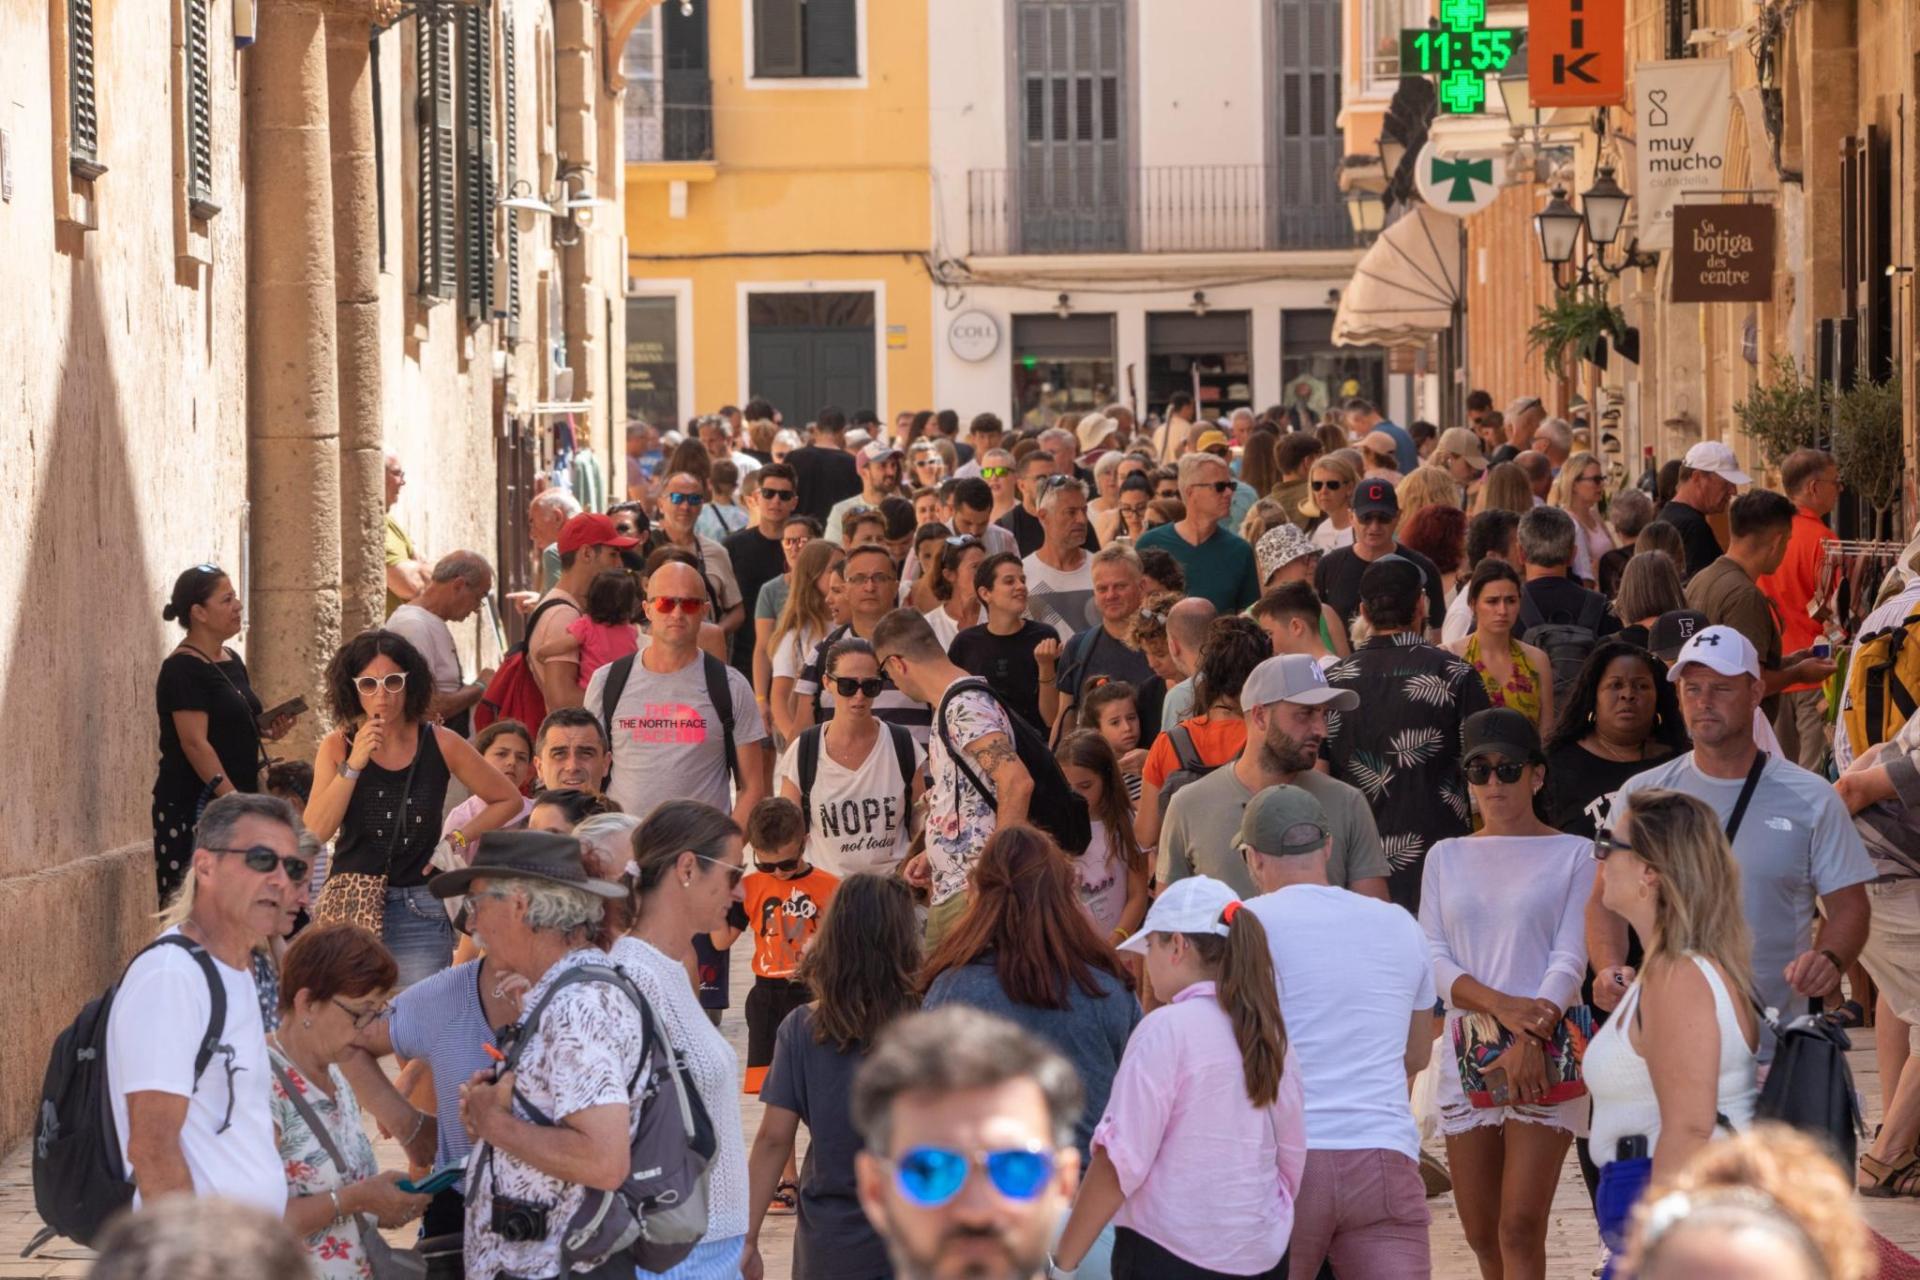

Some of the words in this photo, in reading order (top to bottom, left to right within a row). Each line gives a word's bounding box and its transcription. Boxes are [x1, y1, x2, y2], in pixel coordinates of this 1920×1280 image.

[1413, 31, 1512, 70] 11:55
[1552, 0, 1602, 84] IK
[1648, 137, 1694, 153] muy
[1649, 152, 1722, 172] mucho
[1693, 228, 1754, 258] botiga
[1707, 254, 1727, 268] des
[1700, 268, 1750, 286] centre
[1369, 485, 1382, 500] C
[619, 719, 637, 729] THE
[638, 719, 679, 729] NORTH
[680, 719, 707, 729] FACE
[820, 796, 897, 838] NOPE
[840, 837, 865, 853] not
